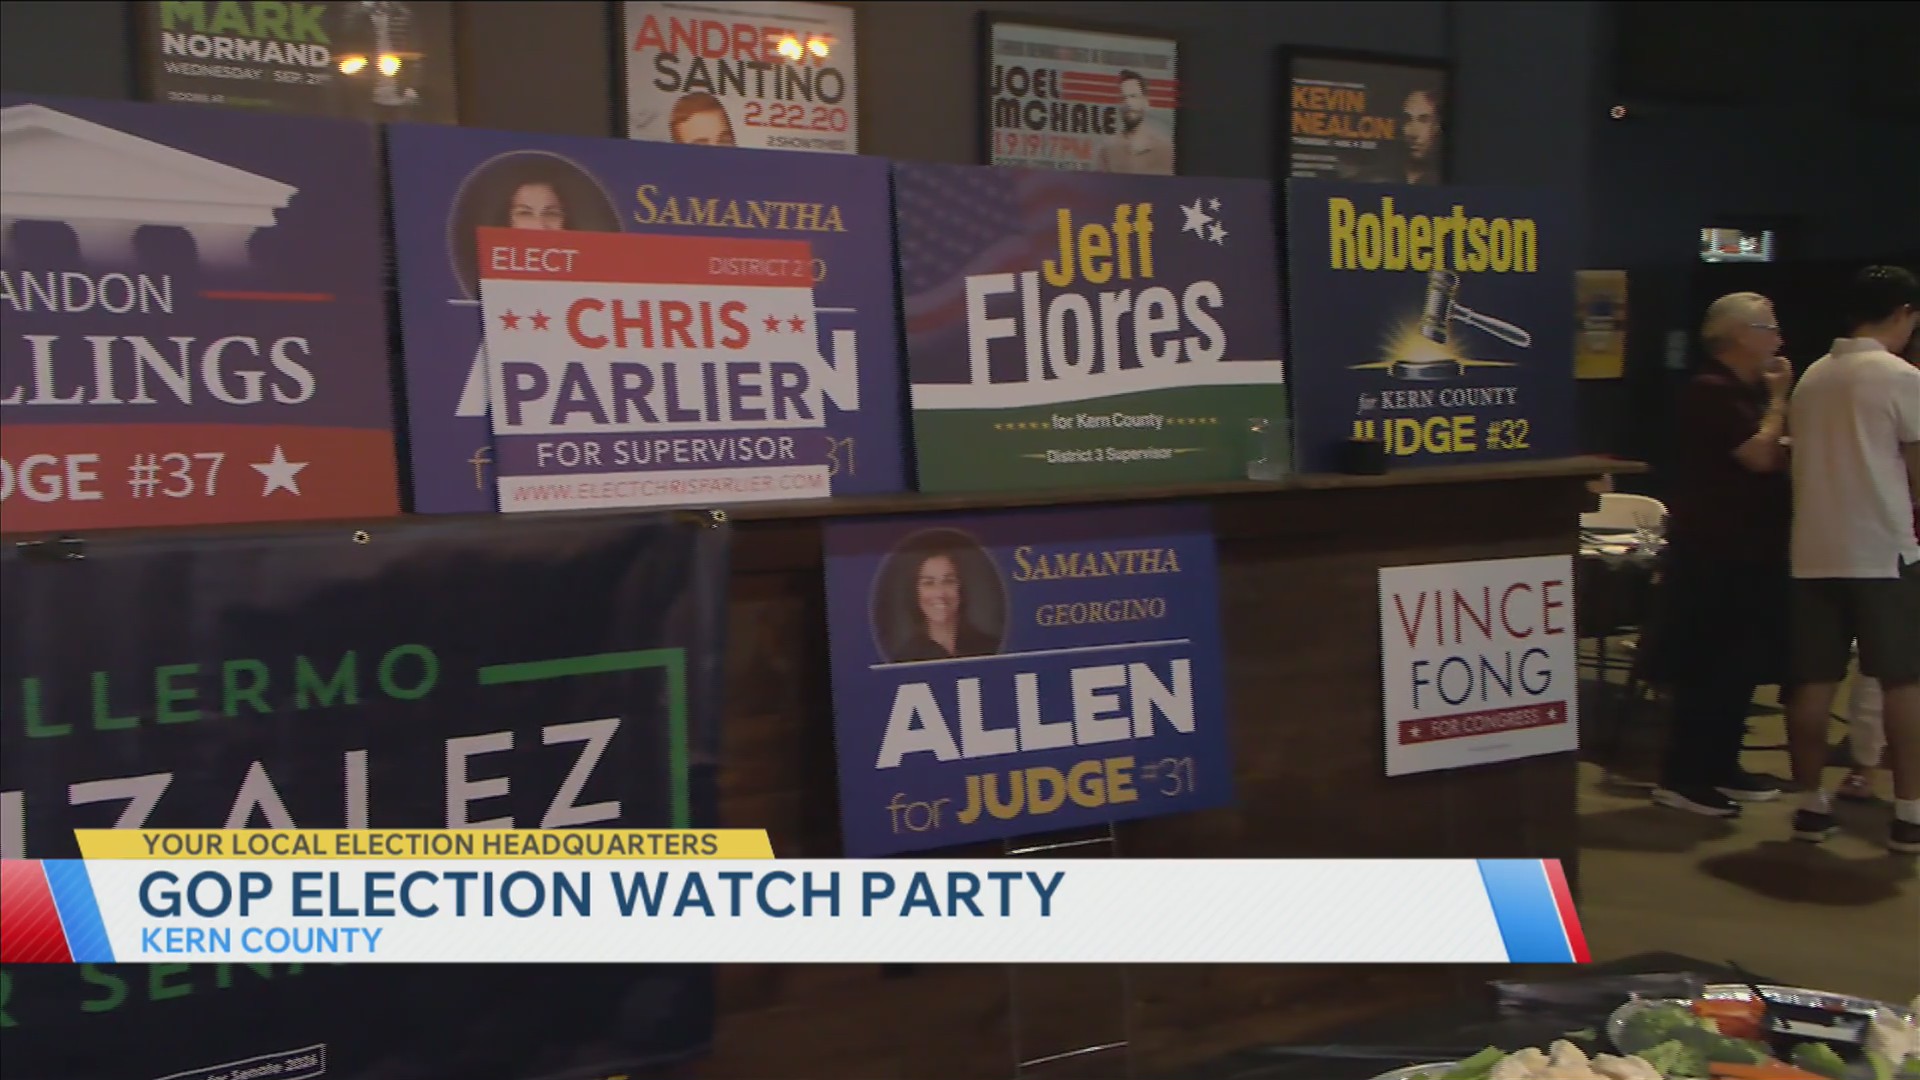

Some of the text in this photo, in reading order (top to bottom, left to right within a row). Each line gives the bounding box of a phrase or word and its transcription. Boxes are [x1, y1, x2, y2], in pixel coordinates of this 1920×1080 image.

[161, 0, 331, 45] MARK
[162, 32, 332, 68] NORMAND
[164, 61, 263, 81] WEDNESDAY
[652, 52, 846, 104] SANTINO
[991, 65, 1061, 99] JOEL
[743, 101, 849, 132] 2.22.20
[995, 98, 1117, 135] MCHALE
[1291, 85, 1366, 113] KEVIN
[1291, 111, 1397, 140] NEALON
[634, 184, 848, 232] SAMANTHA
[1042, 202, 1154, 287] Jeff
[1328, 196, 1538, 273] Robertson
[490, 246, 580, 274] ELECT
[708, 256, 790, 277] DISTRICT
[791, 260, 806, 279] 2
[565, 297, 752, 350] CHRIS
[964, 270, 1228, 384] Flores
[0, 334, 317, 405] LINGS
[502, 361, 816, 426] PARLIER
[1380, 390, 1434, 410] KERN
[1438, 387, 1518, 408] COUNTY
[1051, 413, 1164, 432] for Kern County
[1484, 419, 1531, 450] #32
[536, 436, 796, 468] FOR SUPERVISOR
[1046, 448, 1173, 466] District 3 Supervisor
[128, 453, 225, 498] #37
[512, 473, 824, 502] WWW.ELECTCHRISPARLIER.COM
[1012, 545, 1182, 582] SAMANTHA
[1036, 597, 1167, 627] GEORGINO
[1393, 580, 1566, 649] VINCE
[23, 644, 440, 738] LLERMO
[1411, 648, 1552, 710] FONG
[874, 658, 1196, 770] ALLEN
[1430, 707, 1540, 737] FOR CONGRESS
[886, 756, 1196, 835] for JUDGE #31
[284, 1054, 319, 1073] 2026
